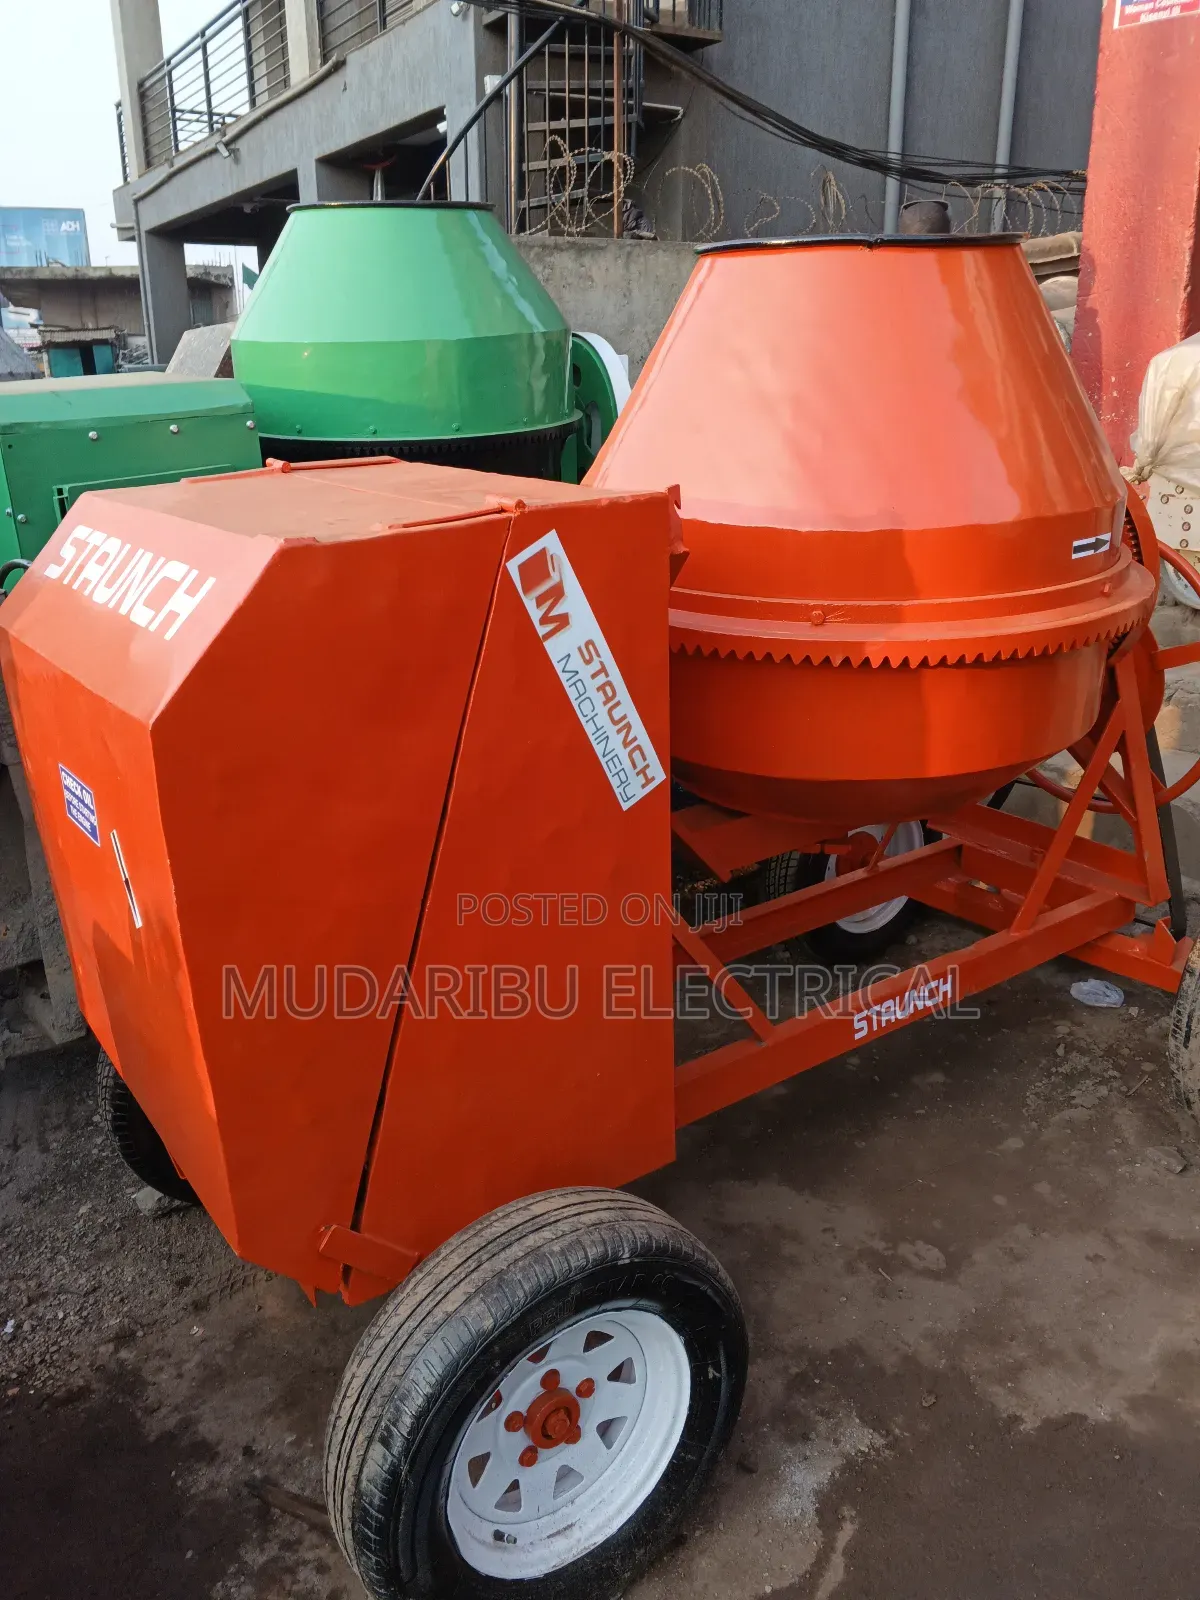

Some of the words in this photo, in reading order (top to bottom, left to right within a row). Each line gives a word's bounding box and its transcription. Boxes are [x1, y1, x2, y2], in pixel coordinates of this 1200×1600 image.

[43, 524, 217, 641] STAUNCH
[557, 653, 636, 804] MACHINERY
[577, 638, 656, 790] STAUNCH
[61, 770, 83, 800] CHECK
[82, 789, 94, 810] OIL
[853, 974, 953, 1040] STAUNCH
